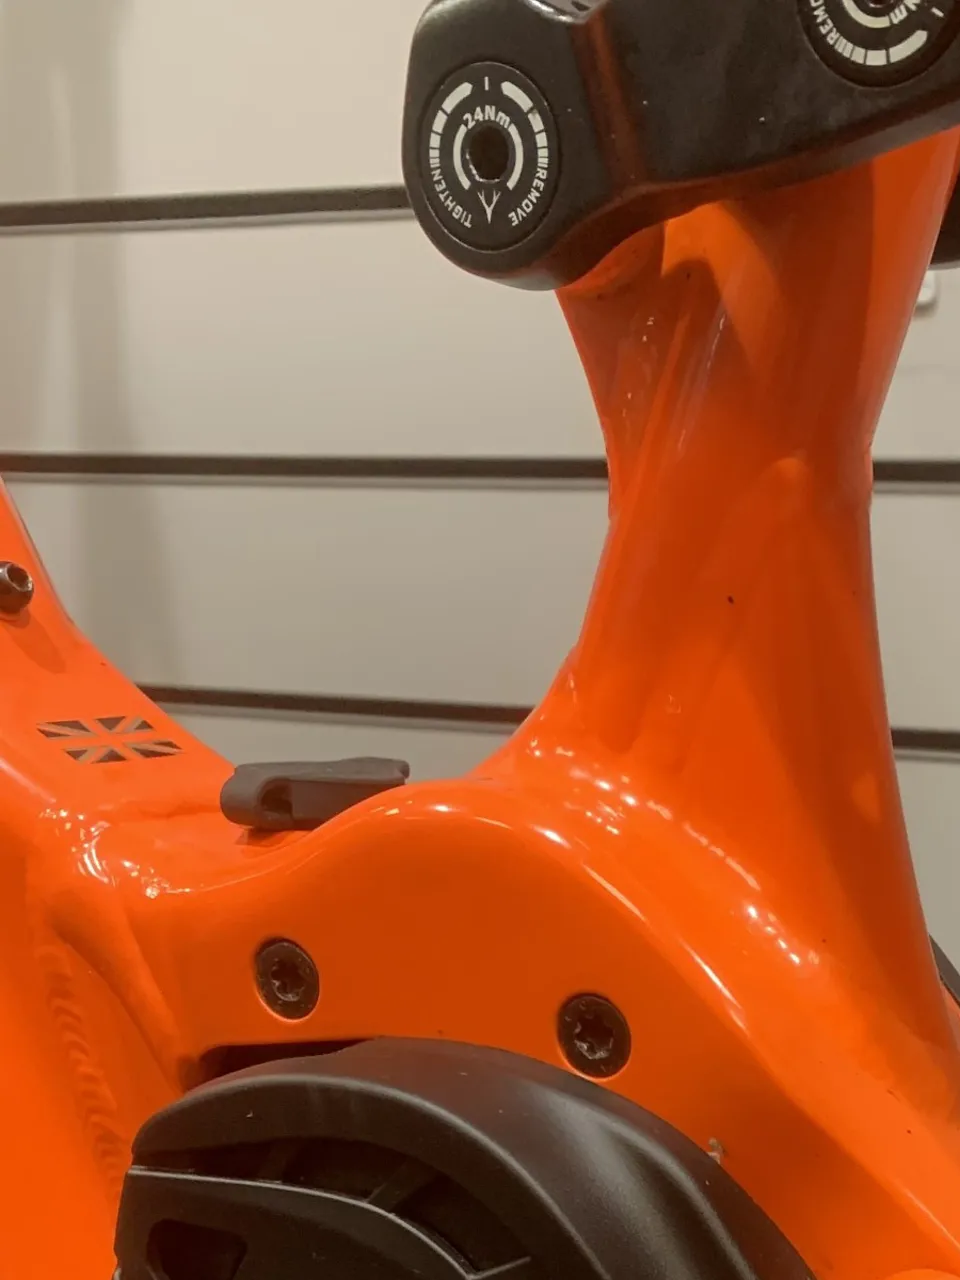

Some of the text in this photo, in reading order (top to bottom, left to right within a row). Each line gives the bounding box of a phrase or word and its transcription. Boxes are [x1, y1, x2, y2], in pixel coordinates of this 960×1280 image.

[463, 104, 511, 130] 24Nm
[431, 167, 473, 229] TIGHTEN
[508, 169, 548, 227] REMOVE
